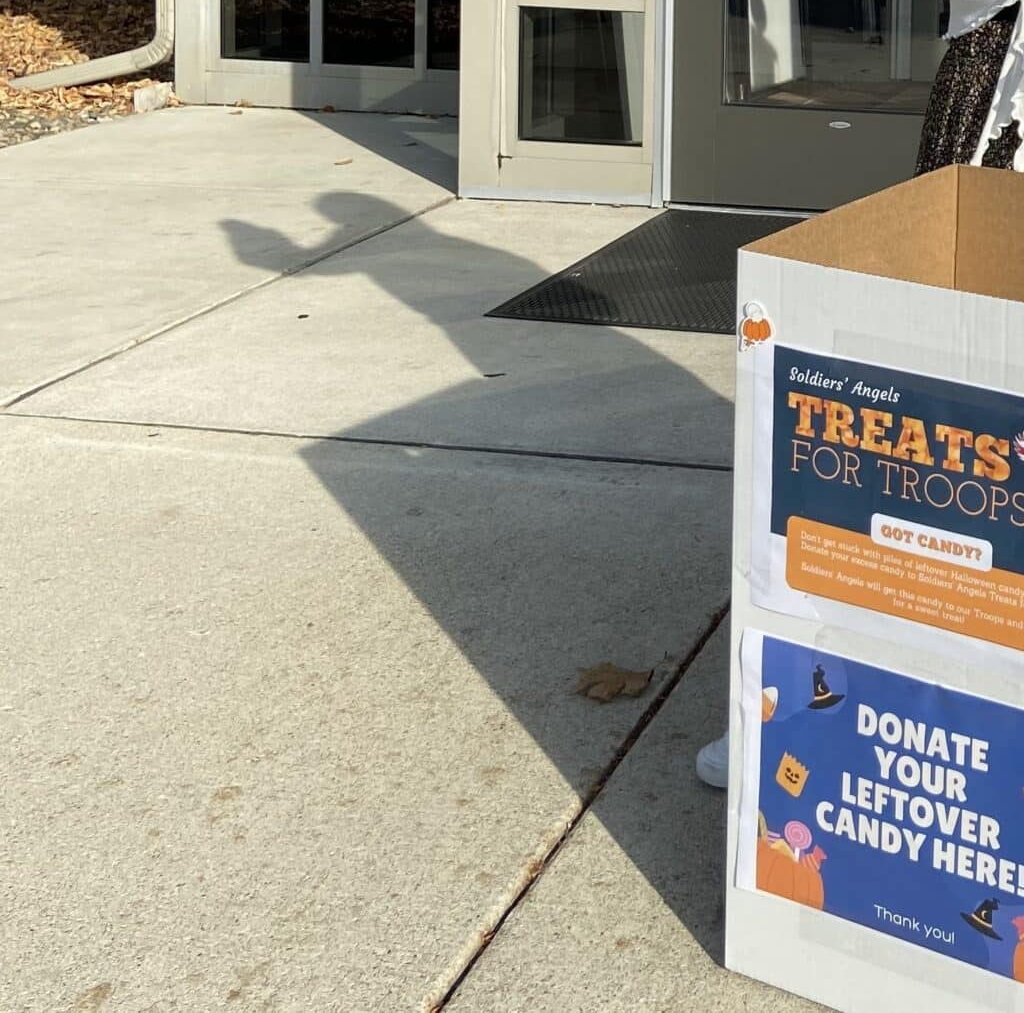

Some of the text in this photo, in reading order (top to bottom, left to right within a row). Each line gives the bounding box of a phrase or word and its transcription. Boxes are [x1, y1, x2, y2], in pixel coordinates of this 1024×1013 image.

[789, 366, 901, 403] Soldiers' Angels
[788, 391, 1011, 482] TREATS
[791, 439, 862, 488] FOR
[823, 538, 836, 548] get
[863, 548, 881, 560] with
[883, 554, 902, 566] piles
[904, 560, 914, 569] of
[915, 561, 947, 576] leftover
[951, 570, 996, 590] Halloween
[998, 584, 1024, 598] candy
[880, 524, 983, 561] GOT CANDY?
[800, 541, 829, 556] Donate
[830, 550, 849, 563] your
[851, 557, 878, 569] excess
[880, 564, 905, 578] candy
[907, 571, 916, 580] to
[956, 583, 987, 598] Angels
[989, 590, 1018, 607] Treats
[836, 571, 864, 587] Angels
[867, 581, 881, 591] will
[883, 586, 897, 596] get
[899, 589, 915, 601] this
[916, 594, 943, 608] candy
[945, 602, 954, 611] to
[956, 605, 970, 615] our
[973, 608, 1005, 625] Troops
[1007, 617, 1024, 629] and
[893, 597, 905, 607] for
[915, 604, 939, 616] sweet
[857, 703, 989, 772] DONATE
[873, 745, 968, 803] YOUR
[816, 800, 927, 862] CANDY
[841, 771, 1001, 850] LEFTOVER
[873, 904, 955, 945] Thank you!
